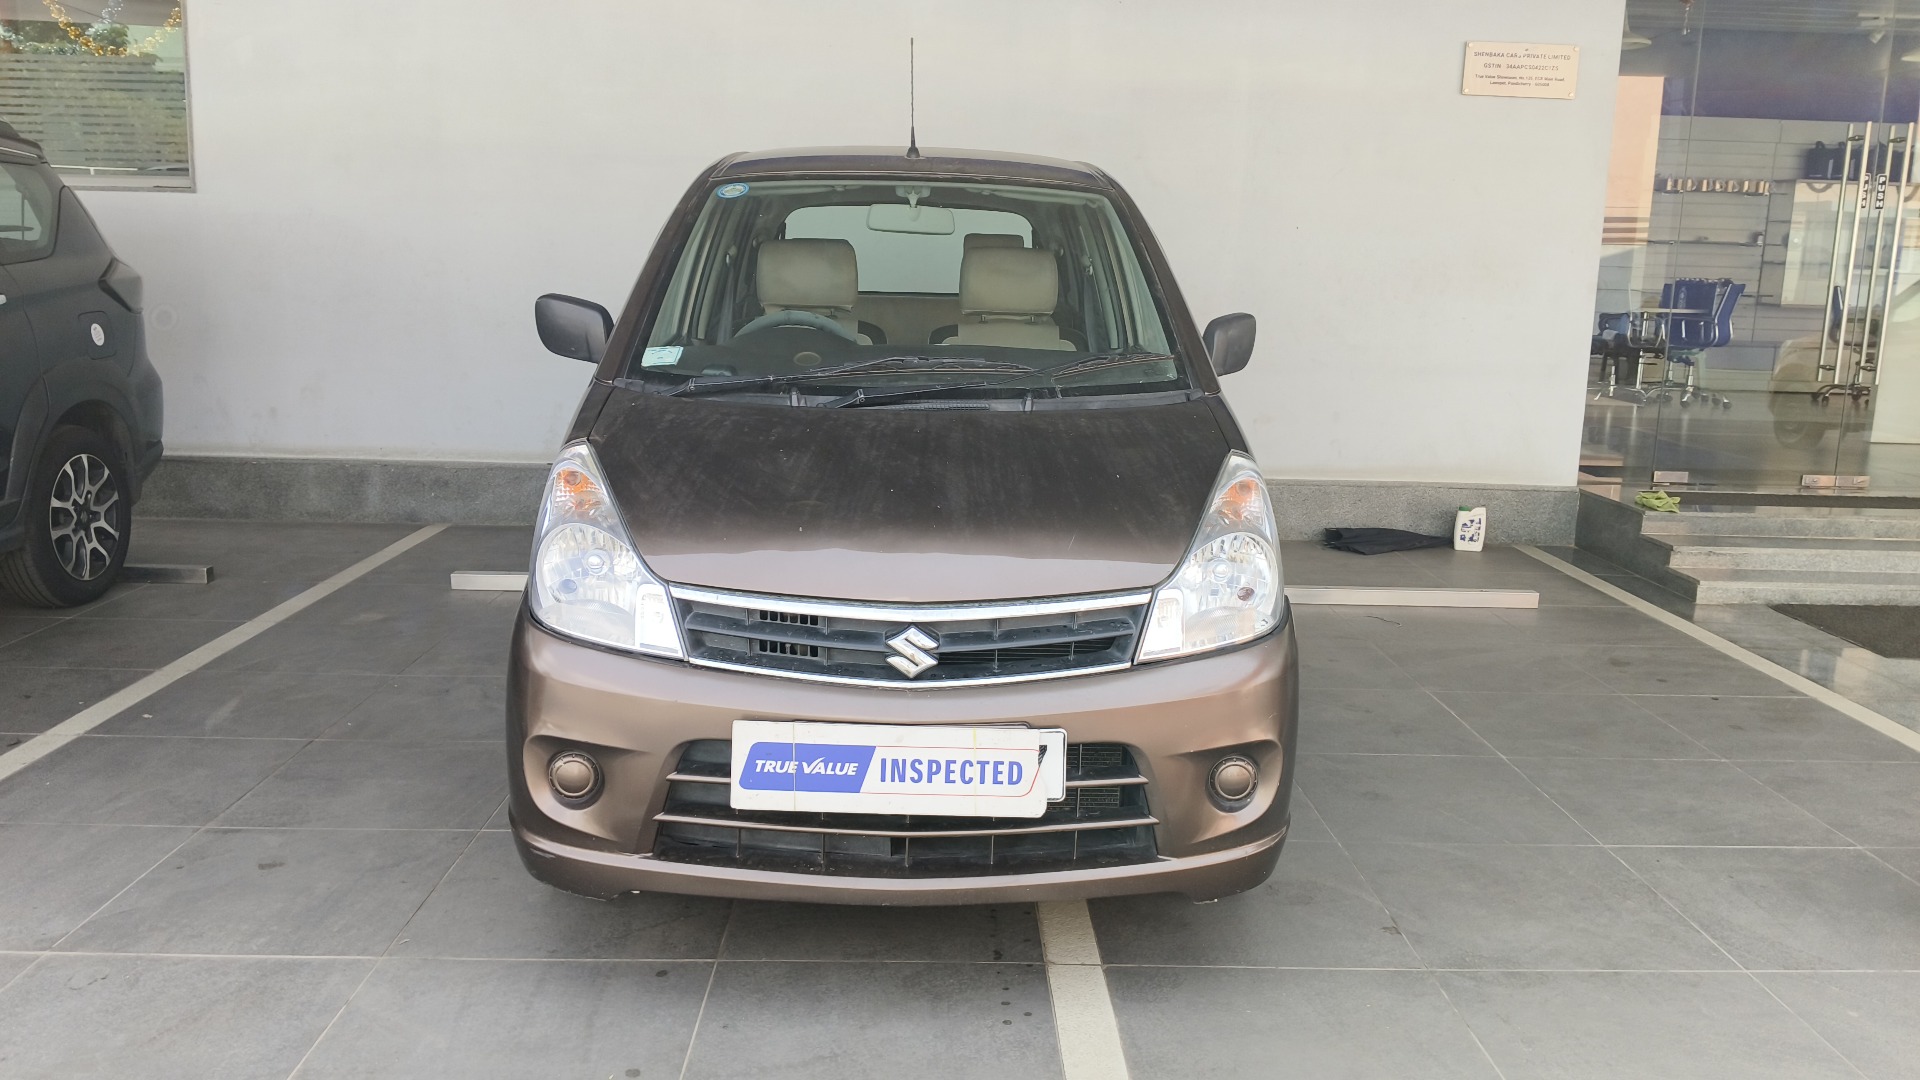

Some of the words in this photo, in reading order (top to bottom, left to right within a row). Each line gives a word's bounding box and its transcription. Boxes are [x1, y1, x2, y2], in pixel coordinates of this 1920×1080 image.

[1875, 176, 1886, 208] PUSH
[755, 759, 799, 774] TRUE
[802, 756, 859, 776] VALUE
[880, 757, 1023, 786] INSPECTED
